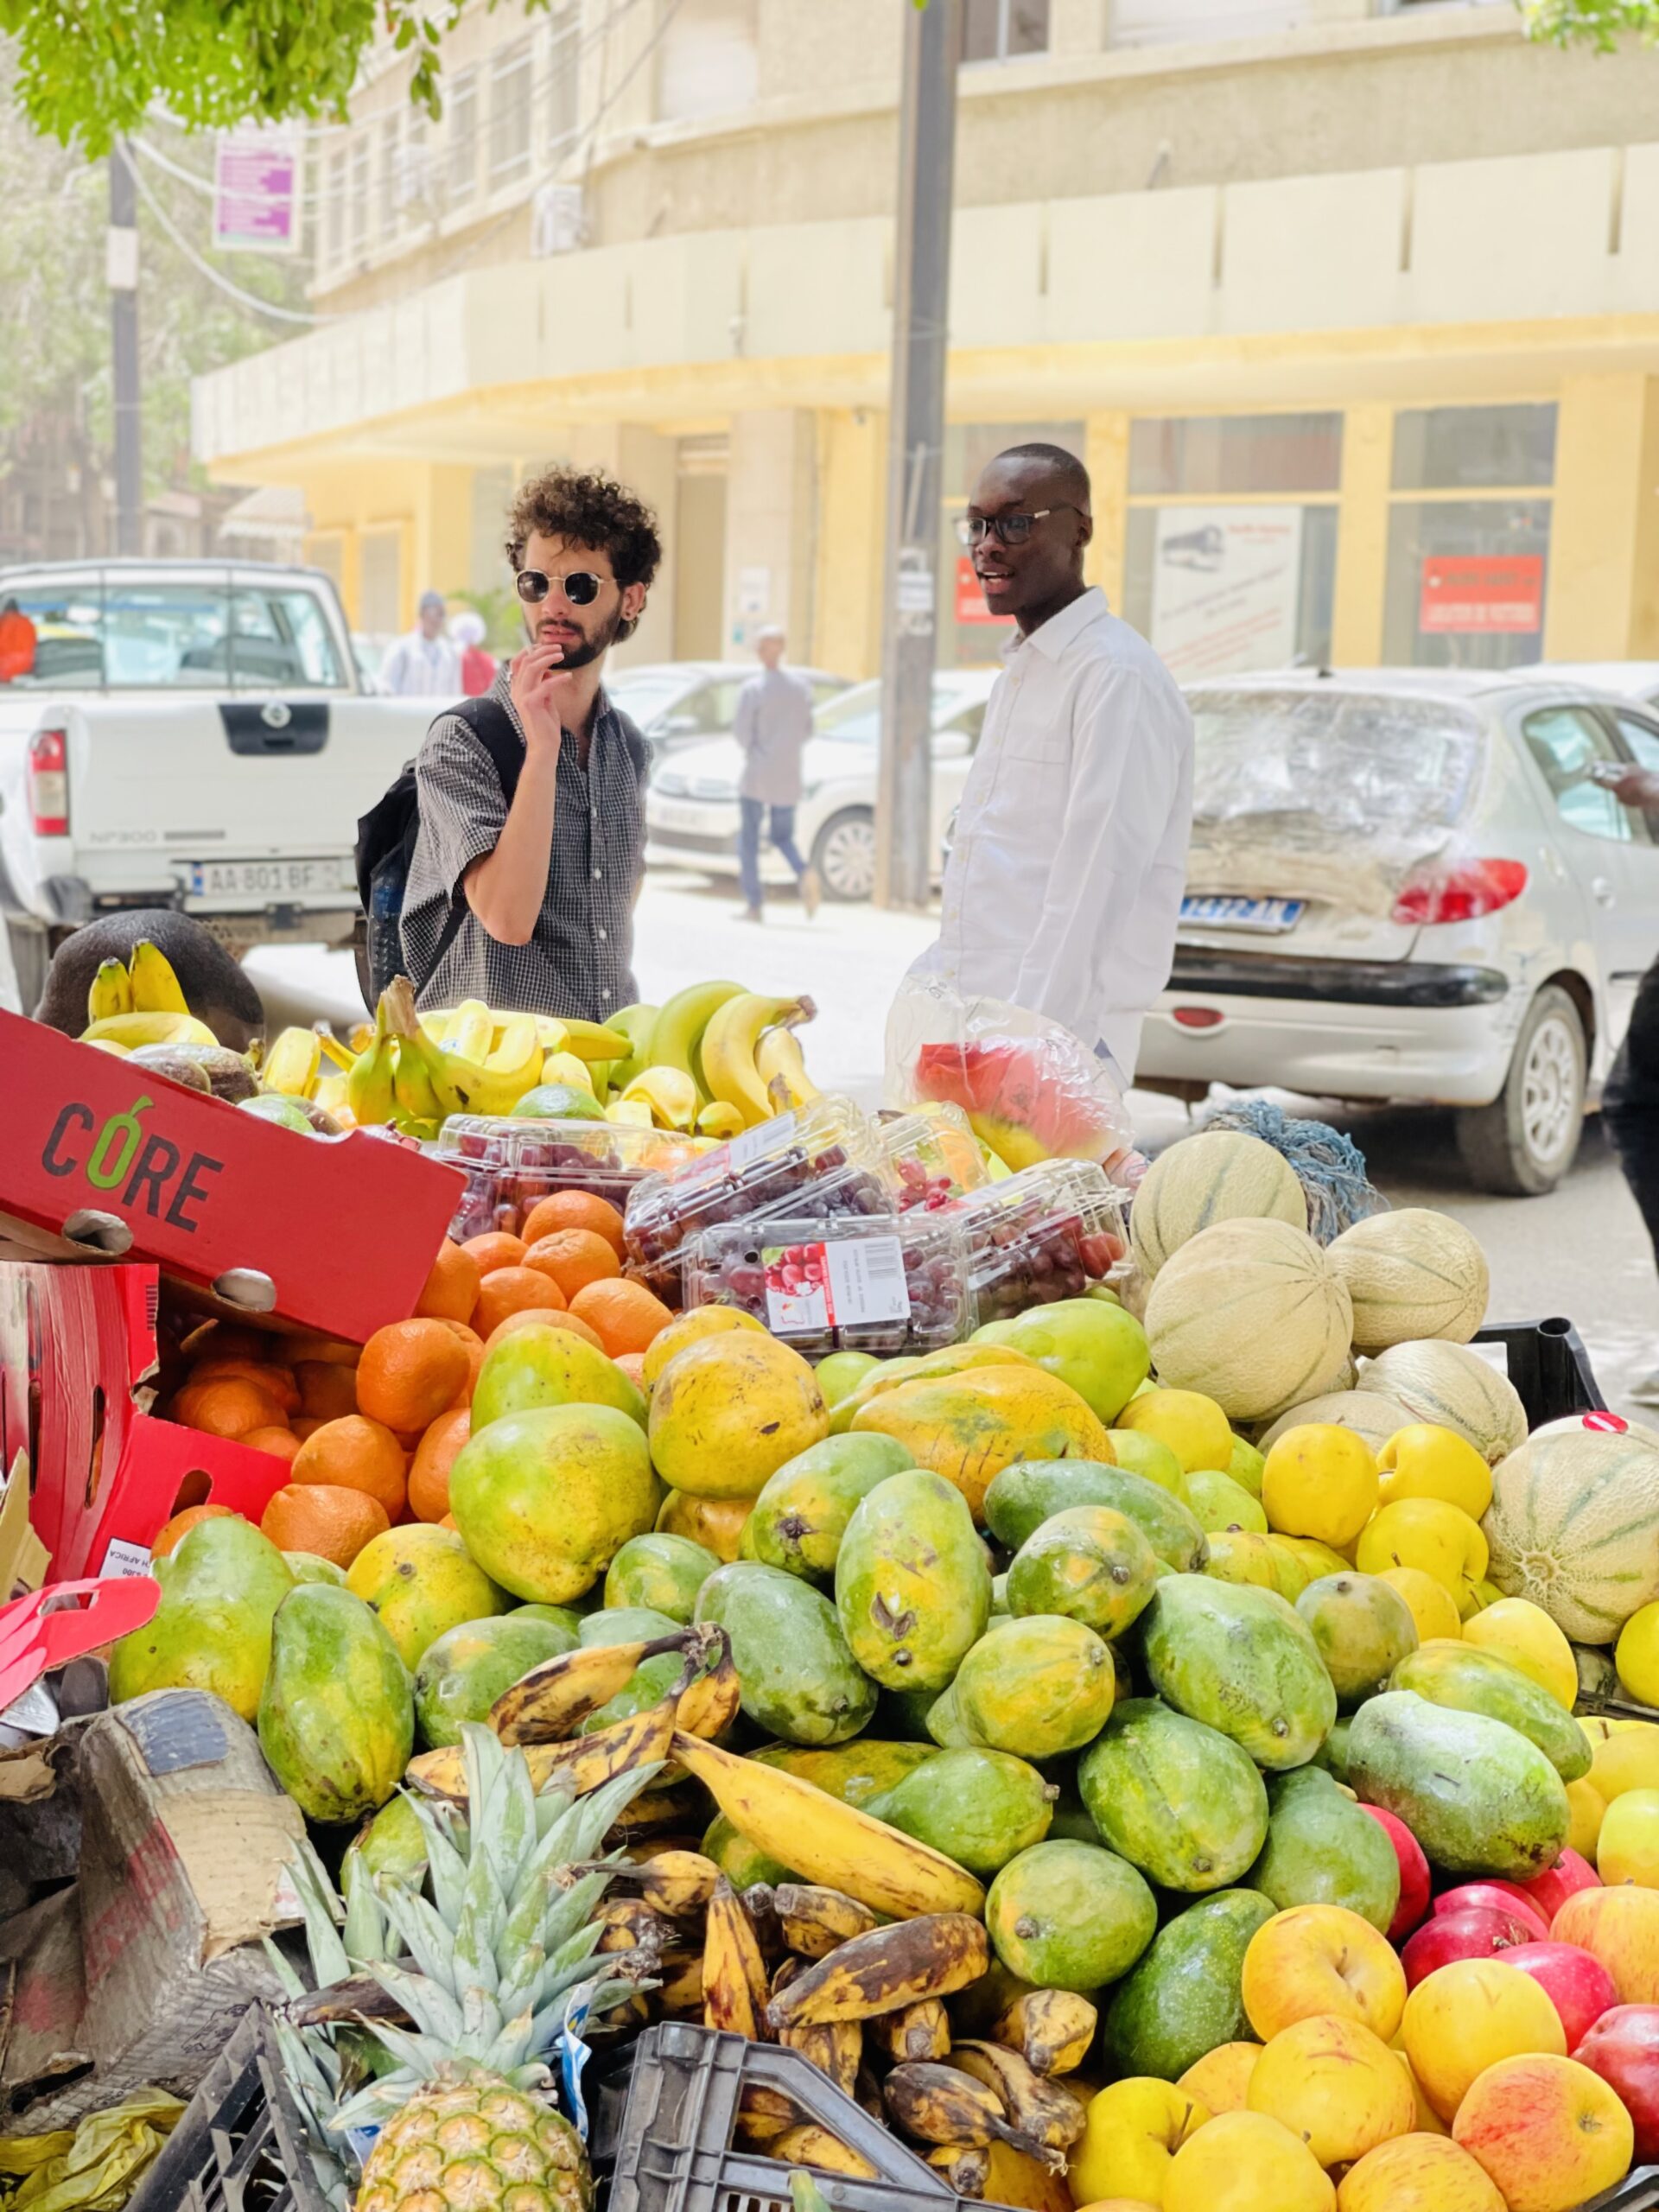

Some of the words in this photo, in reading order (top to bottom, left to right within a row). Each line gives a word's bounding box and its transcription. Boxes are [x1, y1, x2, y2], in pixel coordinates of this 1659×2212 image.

[211, 870, 238, 891] AA
[245, 868, 282, 890] 801
[110, 1550, 140, 1564] AFRICA
